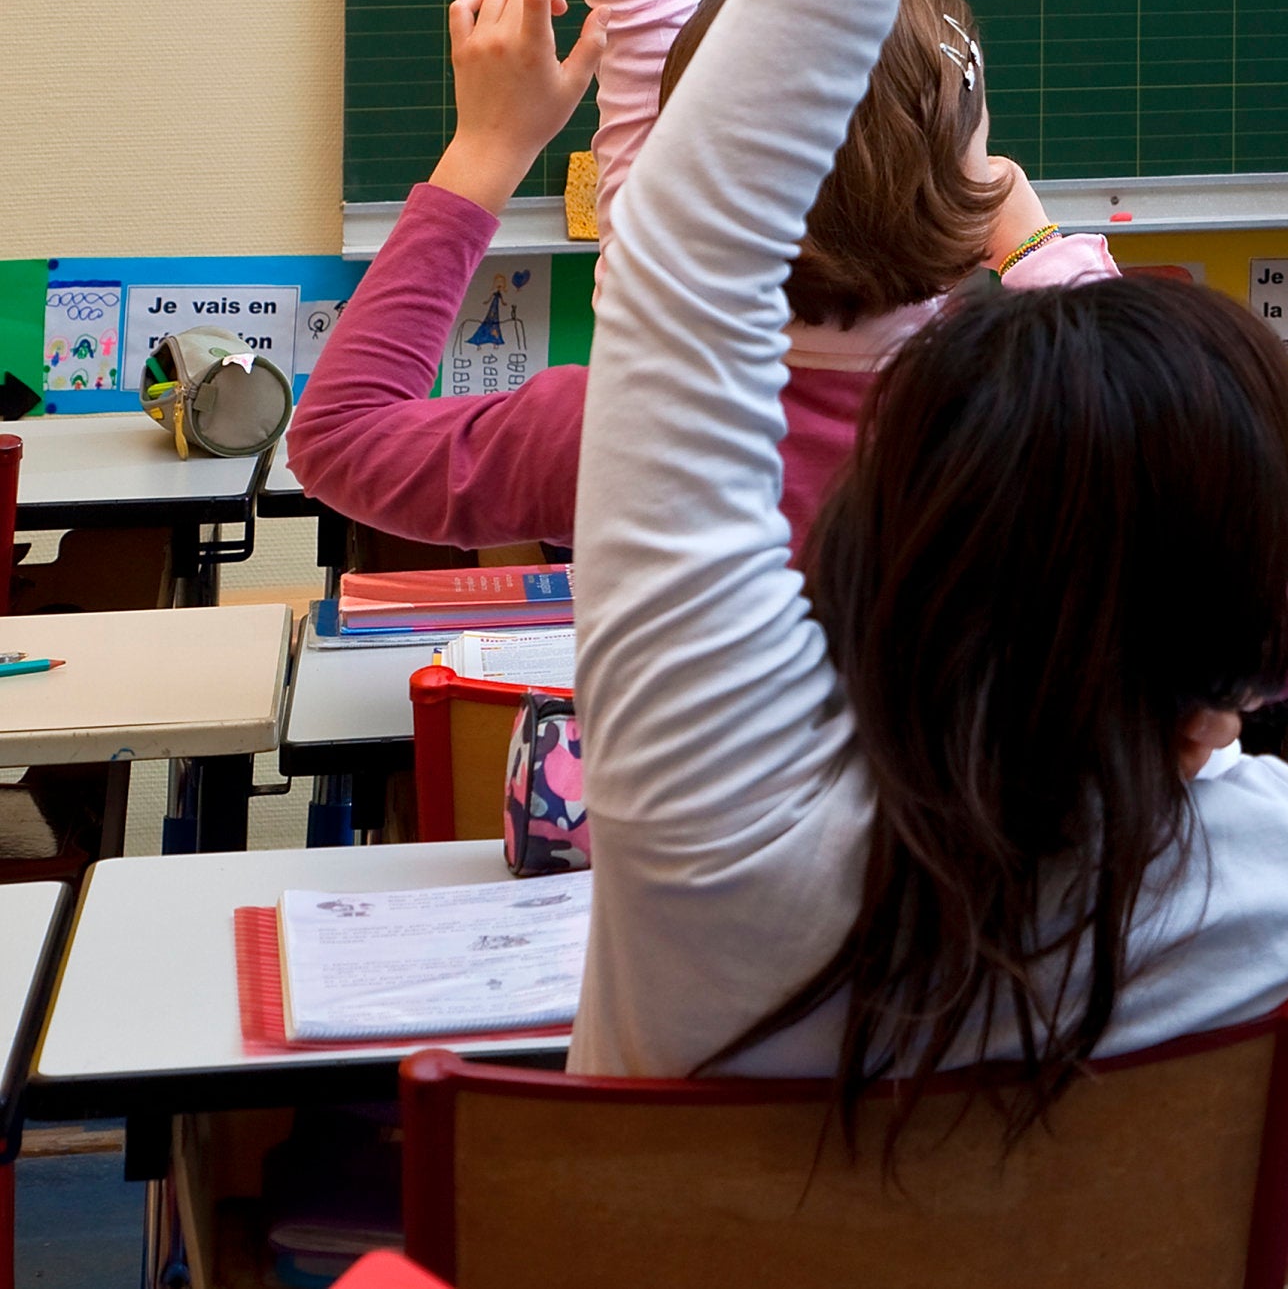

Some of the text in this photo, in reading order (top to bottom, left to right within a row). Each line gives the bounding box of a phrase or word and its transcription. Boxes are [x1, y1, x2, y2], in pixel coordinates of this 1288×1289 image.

[1257, 268, 1284, 285] Je
[148, 297, 277, 314] Je vais en
[1263, 302, 1282, 318] la
